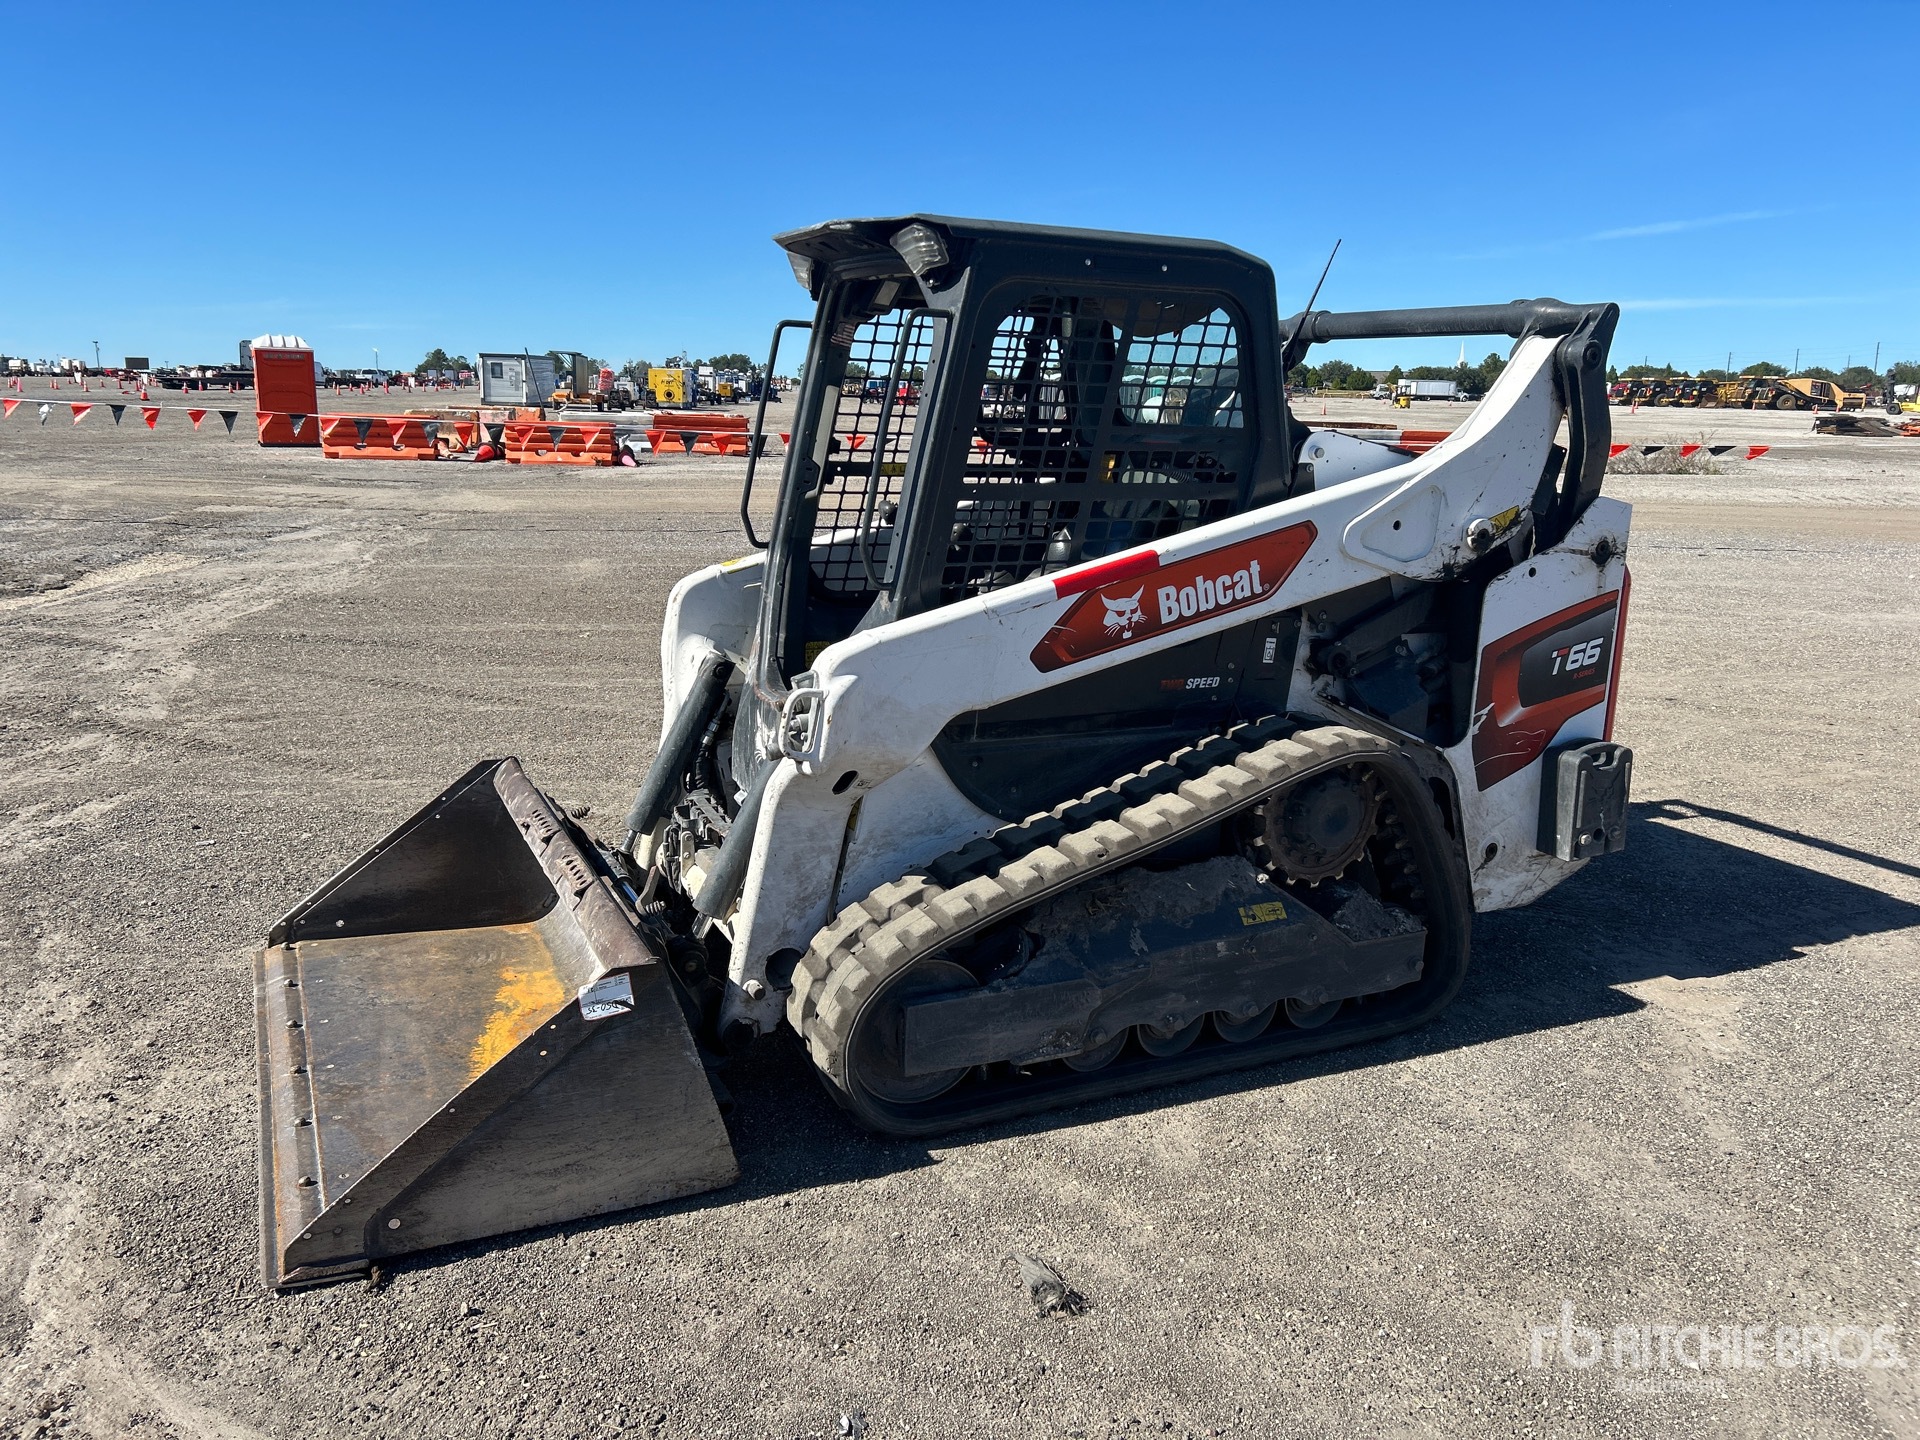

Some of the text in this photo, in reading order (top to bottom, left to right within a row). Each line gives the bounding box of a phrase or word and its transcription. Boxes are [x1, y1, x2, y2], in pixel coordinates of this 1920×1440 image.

[1157, 559, 1262, 625] Bobcat
[1551, 637, 1604, 675] T66
[1185, 676, 1220, 690] SPEED
